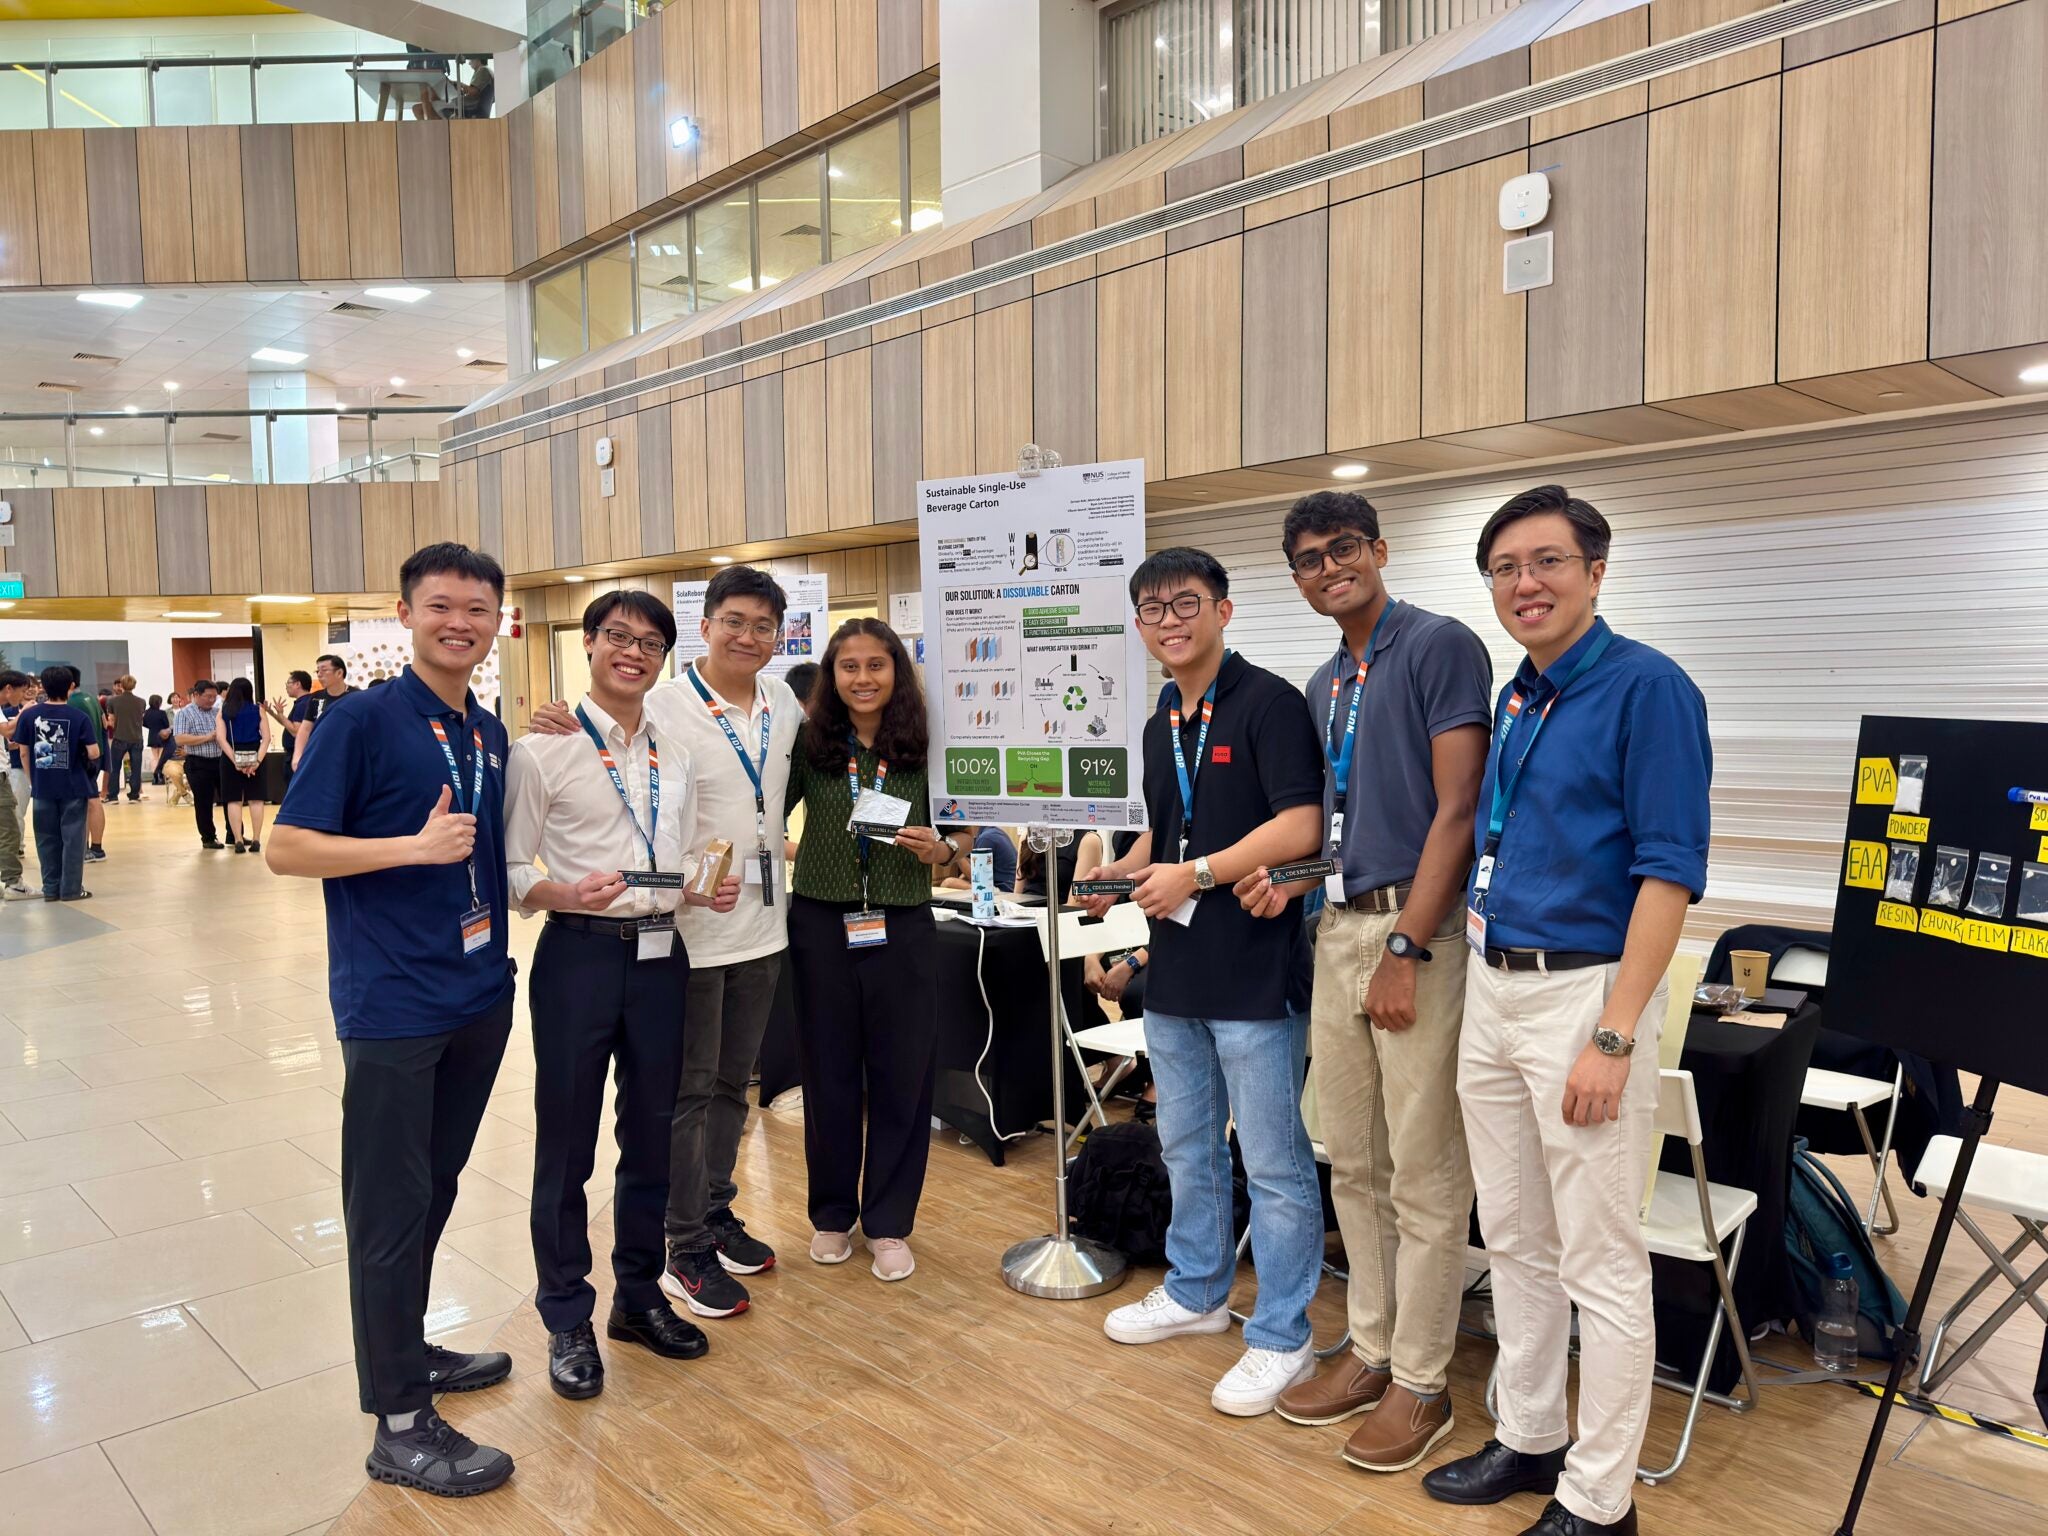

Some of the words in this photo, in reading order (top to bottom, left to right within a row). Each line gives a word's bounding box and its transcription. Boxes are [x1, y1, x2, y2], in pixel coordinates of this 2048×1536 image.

[926, 484, 976, 498] Sustainable
[978, 480, 1026, 494] Single-Use
[926, 501, 967, 513] Beverage
[970, 499, 999, 510] Carton
[945, 592, 958, 601] OUR
[960, 589, 995, 601] SOLUTION:
[996, 589, 1001, 598] A
[1003, 586, 1049, 598] DISSOLVABLE
[1051, 584, 1080, 595] CARTON
[1346, 710, 1356, 734] NUS
[1352, 686, 1361, 706] IDP
[718, 718, 733, 734] NUS
[730, 737, 743, 751] IDP
[1501, 715, 1513, 742] NUS
[1172, 729, 1181, 748] NUS
[441, 744, 456, 766] NUS
[452, 771, 462, 789] IDP
[949, 758, 996, 774] 100%
[1080, 759, 1116, 776] 91%
[1175, 752, 1184, 768] IDP
[610, 770, 622, 789] NUS
[850, 776, 858, 793] NUS
[1861, 766, 1892, 793] PVA
[2035, 807, 2048, 821] SO
[1890, 818, 1926, 836] POWDER
[1850, 846, 1884, 880] EAA
[1880, 906, 1914, 925] RESIN
[1969, 924, 2006, 944] FILM
